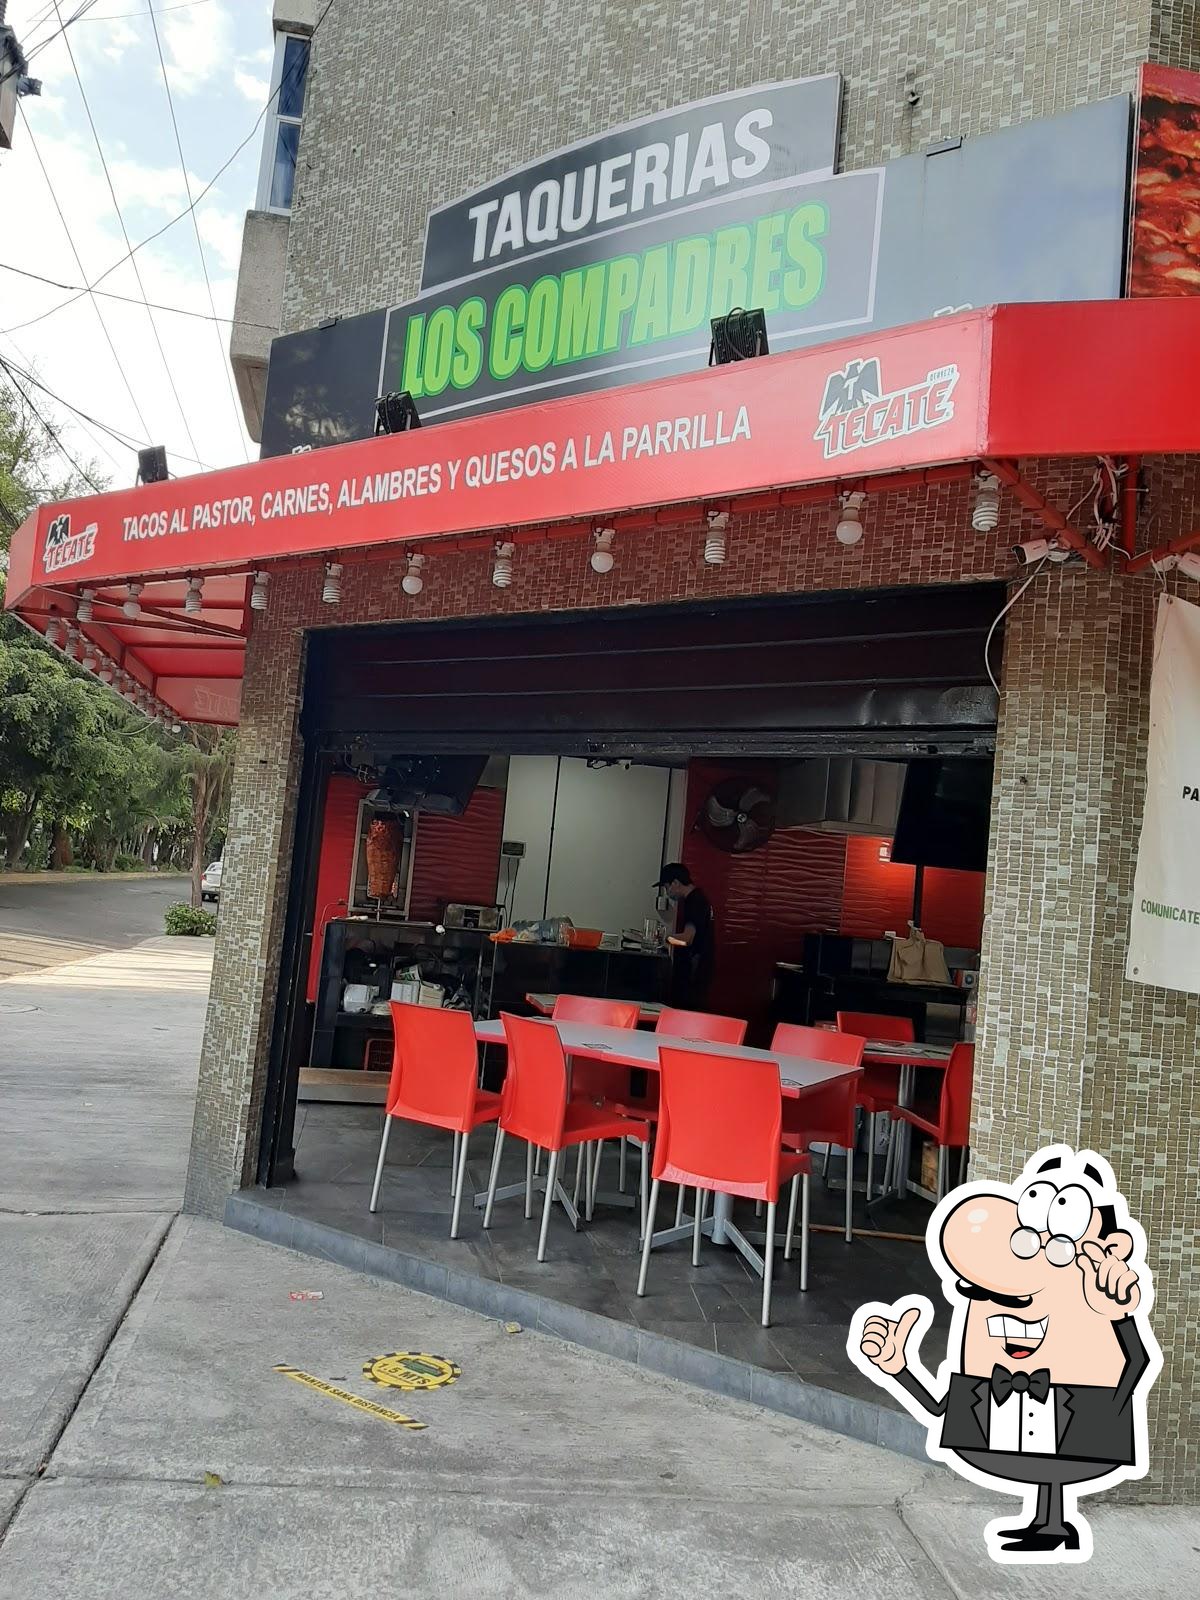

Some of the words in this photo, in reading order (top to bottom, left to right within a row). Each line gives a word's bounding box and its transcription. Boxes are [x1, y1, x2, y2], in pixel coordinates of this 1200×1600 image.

[469, 108, 773, 263] TAQUERIAS
[401, 296, 487, 399] LOS
[488, 201, 830, 380] COMPADRES
[122, 510, 168, 541] TACOS
[169, 508, 189, 534] AL
[191, 496, 256, 527] PASTOR,
[260, 482, 333, 515] CARNES,
[337, 463, 442, 509] ALAMBRES
[447, 459, 462, 490] Y
[465, 441, 556, 488] QUESOS
[560, 438, 578, 471] A
[583, 431, 615, 468] LA
[621, 405, 752, 461] PARRILLA
[814, 378, 956, 459] TECATE
[43, 532, 96, 573] TECATE
